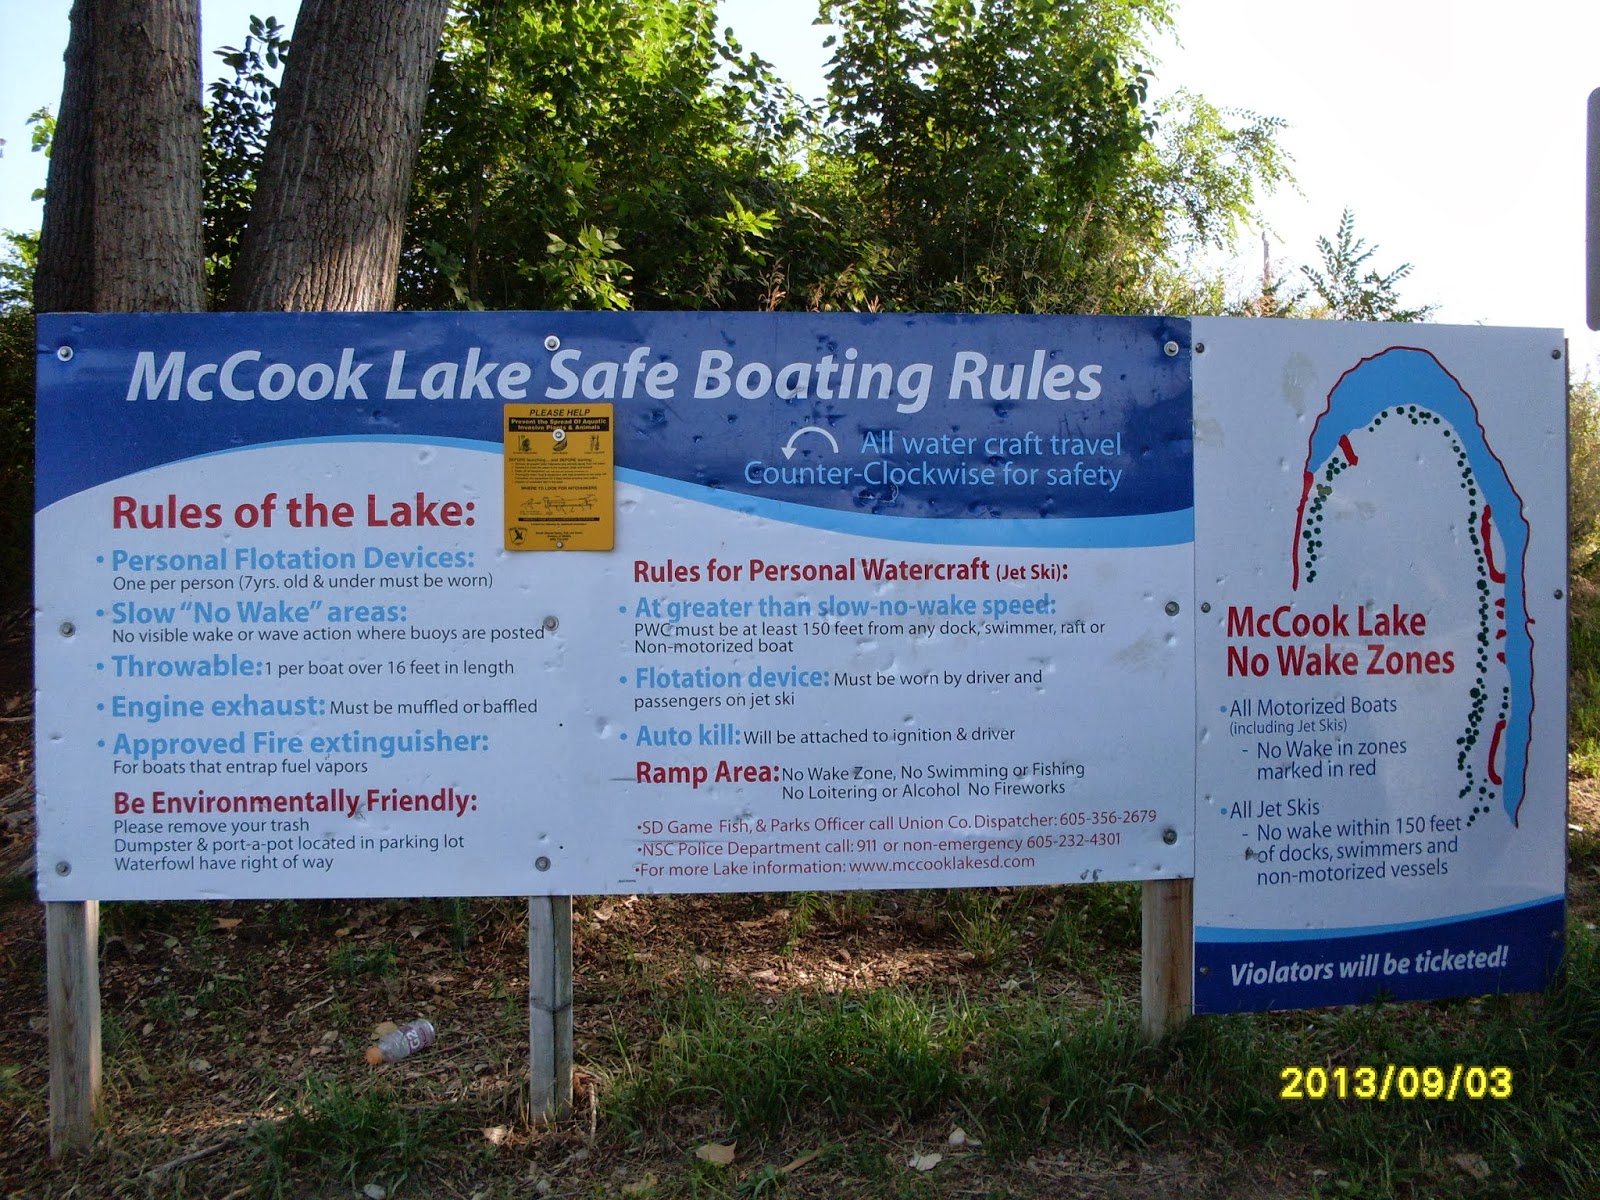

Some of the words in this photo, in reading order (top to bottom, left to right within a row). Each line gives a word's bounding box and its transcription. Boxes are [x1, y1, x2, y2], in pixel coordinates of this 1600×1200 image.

[126, 350, 373, 401] McCook
[385, 349, 531, 400] Lake
[545, 348, 678, 399] Safe
[693, 347, 934, 414] Boating
[949, 350, 1102, 400] Rules
[861, 432, 894, 454] All
[902, 436, 980, 455] water
[984, 431, 1043, 456] craft
[1050, 432, 1121, 456] travel
[744, 460, 995, 485] Counter-Clockwise
[1002, 462, 1039, 485] for
[1046, 462, 1123, 492] safety
[114, 494, 222, 529] Rules
[234, 493, 277, 528] of
[286, 493, 354, 528] the
[368, 492, 474, 526] Lake:
[112, 548, 226, 571] Personal
[236, 547, 355, 570] Flotation
[364, 546, 474, 568] Devices:
[635, 560, 700, 582] Rules
[707, 559, 742, 582] for
[750, 558, 854, 581] Personal
[861, 558, 989, 580] Watercraft
[114, 577, 146, 590] One
[151, 580, 176, 592] per
[181, 579, 233, 592] person
[284, 574, 308, 588] old
[313, 574, 324, 588] &
[329, 574, 375, 588] under
[380, 576, 419, 587] must
[424, 573, 443, 587] be
[112, 602, 176, 624] Slow
[328, 606, 406, 622] areas:
[635, 596, 661, 618] At
[667, 598, 752, 623] greater
[758, 595, 811, 617] than
[818, 594, 976, 616] slow-no-wake
[983, 593, 1056, 619] speed:
[1228, 604, 1350, 637] McCook
[1358, 604, 1426, 636] Lake
[636, 638, 752, 653] Non-motorized
[759, 638, 793, 652] boat
[1228, 646, 1269, 677] No
[1277, 644, 1358, 676] Wake
[1367, 644, 1454, 674] Zones
[637, 668, 741, 688] Flotation
[748, 668, 829, 688] device:
[834, 672, 872, 686] Must
[877, 672, 895, 686] be
[900, 670, 938, 685] worn
[944, 670, 962, 688] by
[966, 670, 1010, 684] driver
[1014, 669, 1042, 683] and
[635, 697, 721, 712] passengers
[726, 693, 745, 706] on
[750, 693, 770, 709] jet
[775, 691, 794, 705] ski
[1230, 699, 1251, 717] All
[1258, 697, 1345, 716] Motorized
[1352, 697, 1397, 713] Boats
[1298, 720, 1315, 732] Jet
[113, 732, 245, 759] Approved
[254, 731, 302, 753] Fire
[310, 730, 488, 757] extinguisher:
[1258, 742, 1281, 758] No
[1286, 740, 1332, 758] Wake
[1338, 740, 1352, 756] in
[1358, 741, 1406, 755] zones
[114, 758, 139, 774] For
[143, 758, 185, 774] boats
[190, 760, 222, 773] that
[226, 762, 277, 776] entrap
[282, 759, 310, 773] fuel
[316, 759, 368, 776] vapors
[636, 761, 708, 789] Ramp
[715, 761, 780, 783] Area:
[783, 768, 804, 781] No
[808, 766, 849, 780] Wake
[853, 766, 896, 781] Zone,
[902, 766, 922, 778] No
[928, 764, 1008, 779] Swimming
[1013, 766, 1028, 779] or
[1033, 762, 1084, 778] Fishing
[1258, 760, 1322, 780] marked
[1328, 760, 1343, 777] in
[1350, 758, 1375, 776] red
[114, 791, 144, 814] Be
[152, 789, 360, 817] Environmentally
[367, 788, 478, 817] Friendly:
[783, 786, 804, 799] No
[810, 785, 876, 801] Loitering
[882, 788, 898, 798] or
[902, 782, 959, 797] Alcohol
[969, 783, 989, 796] No
[995, 780, 1065, 795] Fireworks
[1230, 801, 1251, 818] All
[1257, 801, 1282, 818] Jet
[1288, 800, 1319, 816] Skis
[1258, 824, 1281, 841] No
[1287, 821, 1332, 839] wake
[1337, 818, 1389, 836] within
[1397, 817, 1425, 834] 150
[1430, 816, 1461, 832] feet
[115, 839, 192, 854] Dumpster
[197, 838, 208, 851] &
[213, 835, 293, 854] port-a-pot
[299, 834, 355, 850] located
[361, 836, 374, 849] in
[380, 834, 438, 852] parking
[445, 834, 464, 848] lot
[1258, 845, 1275, 862] of
[1280, 843, 1333, 862] docks,
[1337, 841, 1422, 859] swimmers
[1427, 836, 1457, 854] and
[114, 856, 194, 870] Waterfowl
[200, 856, 236, 870] have
[242, 855, 278, 872] right
[283, 854, 299, 868] of
[302, 858, 333, 872] way
[670, 866, 708, 876] more
[714, 862, 748, 875] Lake
[753, 860, 845, 874] information:
[849, 855, 1034, 872] www.mccooklakesd.com
[1258, 861, 1385, 885] non-motorized
[1391, 858, 1448, 877] vessels
[1232, 960, 1334, 986] Violators
[1340, 954, 1379, 978] will
[1384, 953, 1410, 975] be
[1416, 945, 1508, 973] ticketed!
